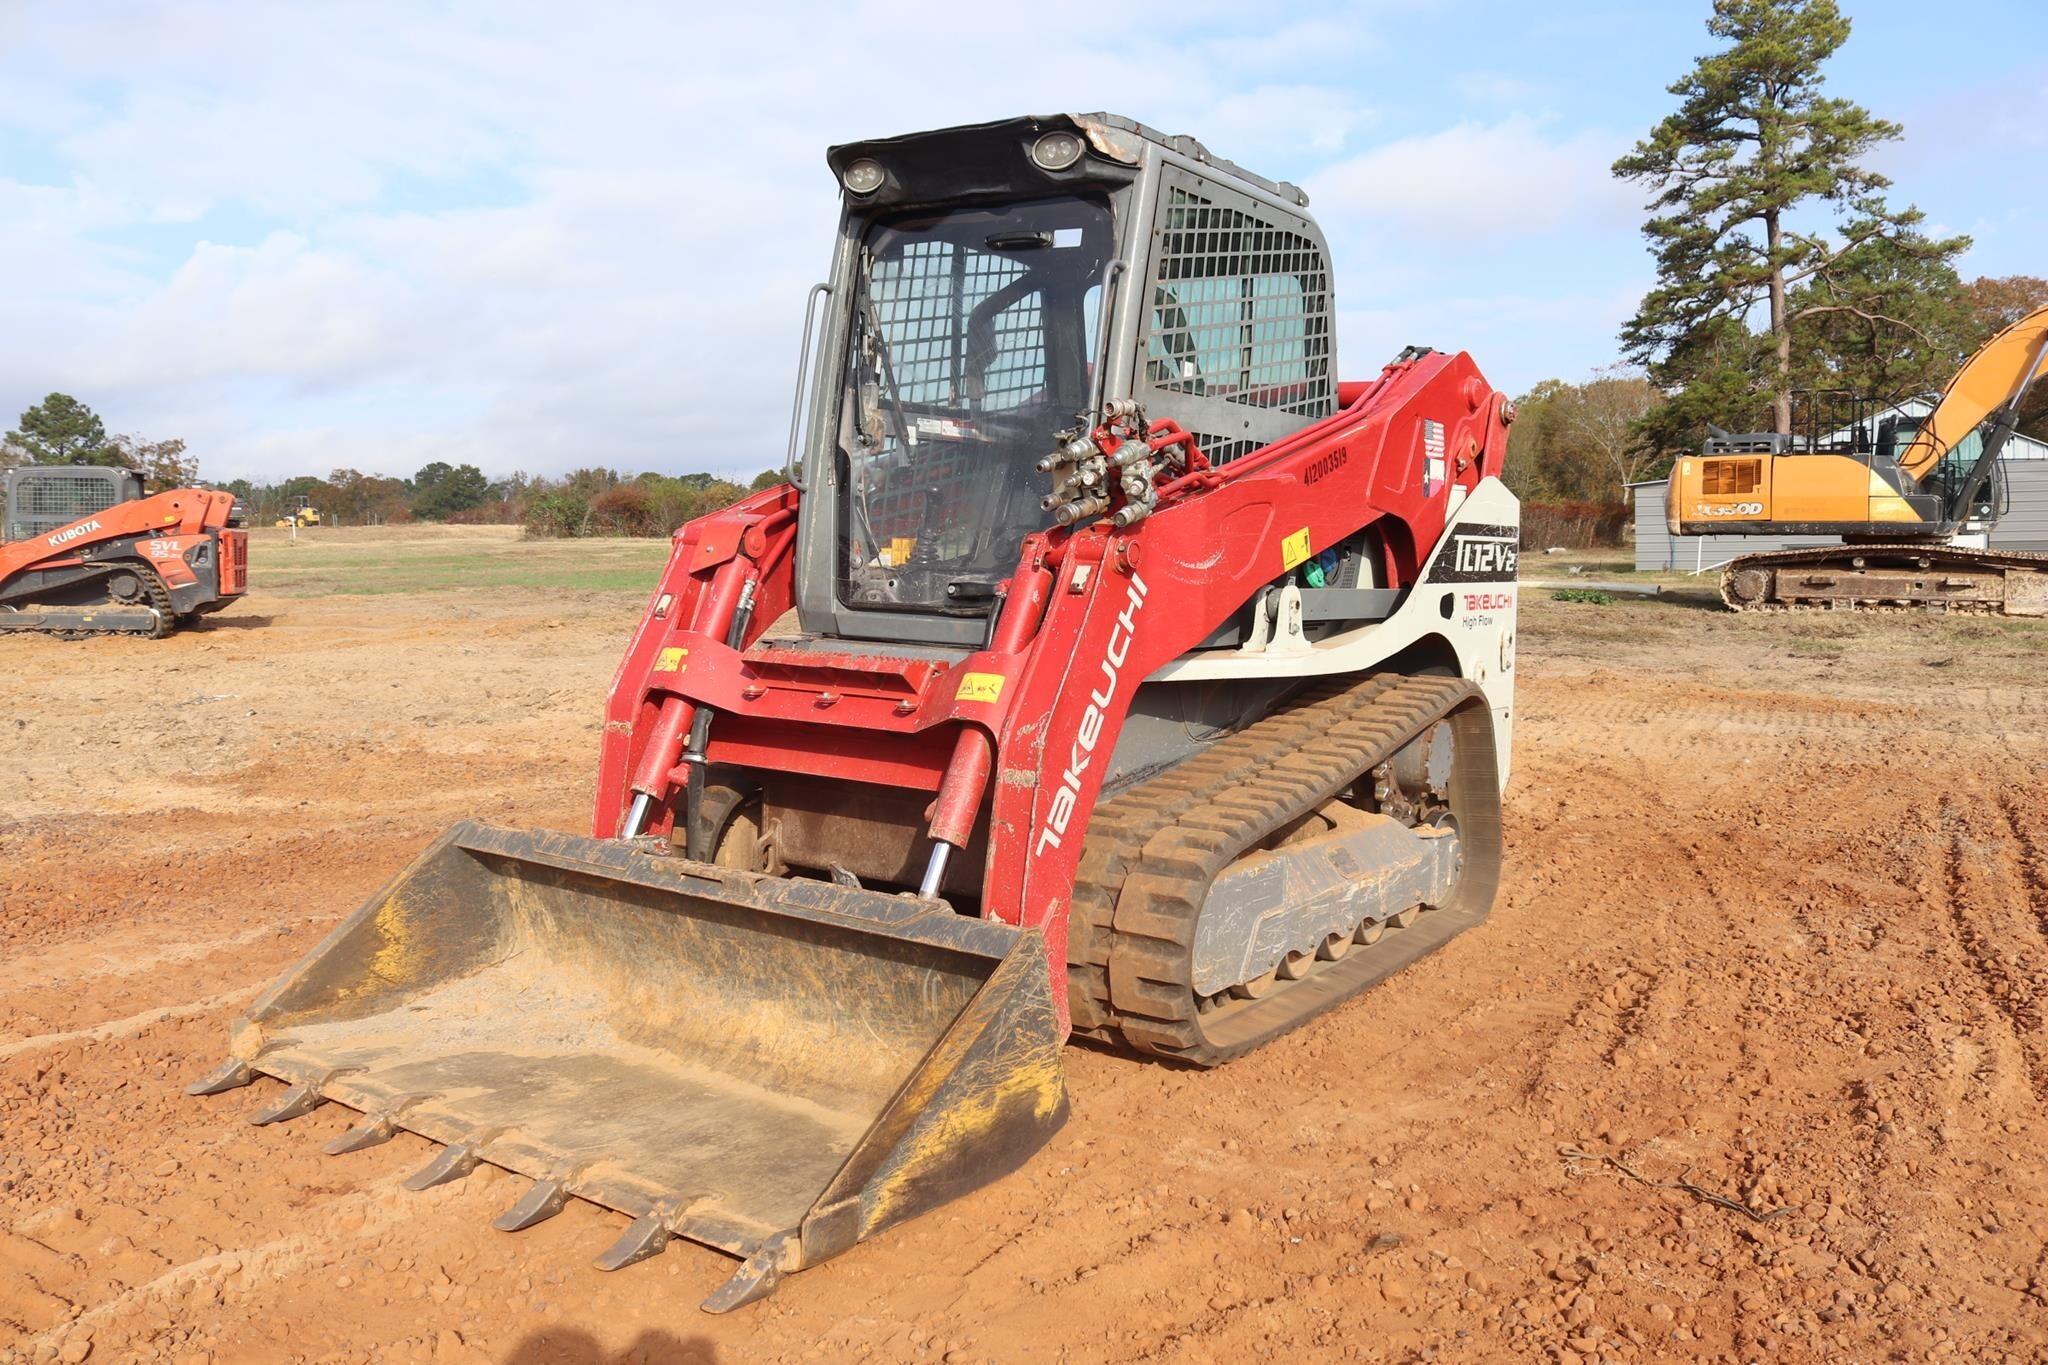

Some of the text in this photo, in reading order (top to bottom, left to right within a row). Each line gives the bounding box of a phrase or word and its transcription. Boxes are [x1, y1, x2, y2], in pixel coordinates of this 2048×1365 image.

[1304, 447, 1347, 486] 412003519
[48, 520, 101, 546] KUBOTA
[149, 540, 182, 550] SVL
[1463, 594, 1513, 611] TAKEUCHI
[1462, 614, 1494, 630] High Flow
[1035, 572, 1148, 857] TAKEUCHI
